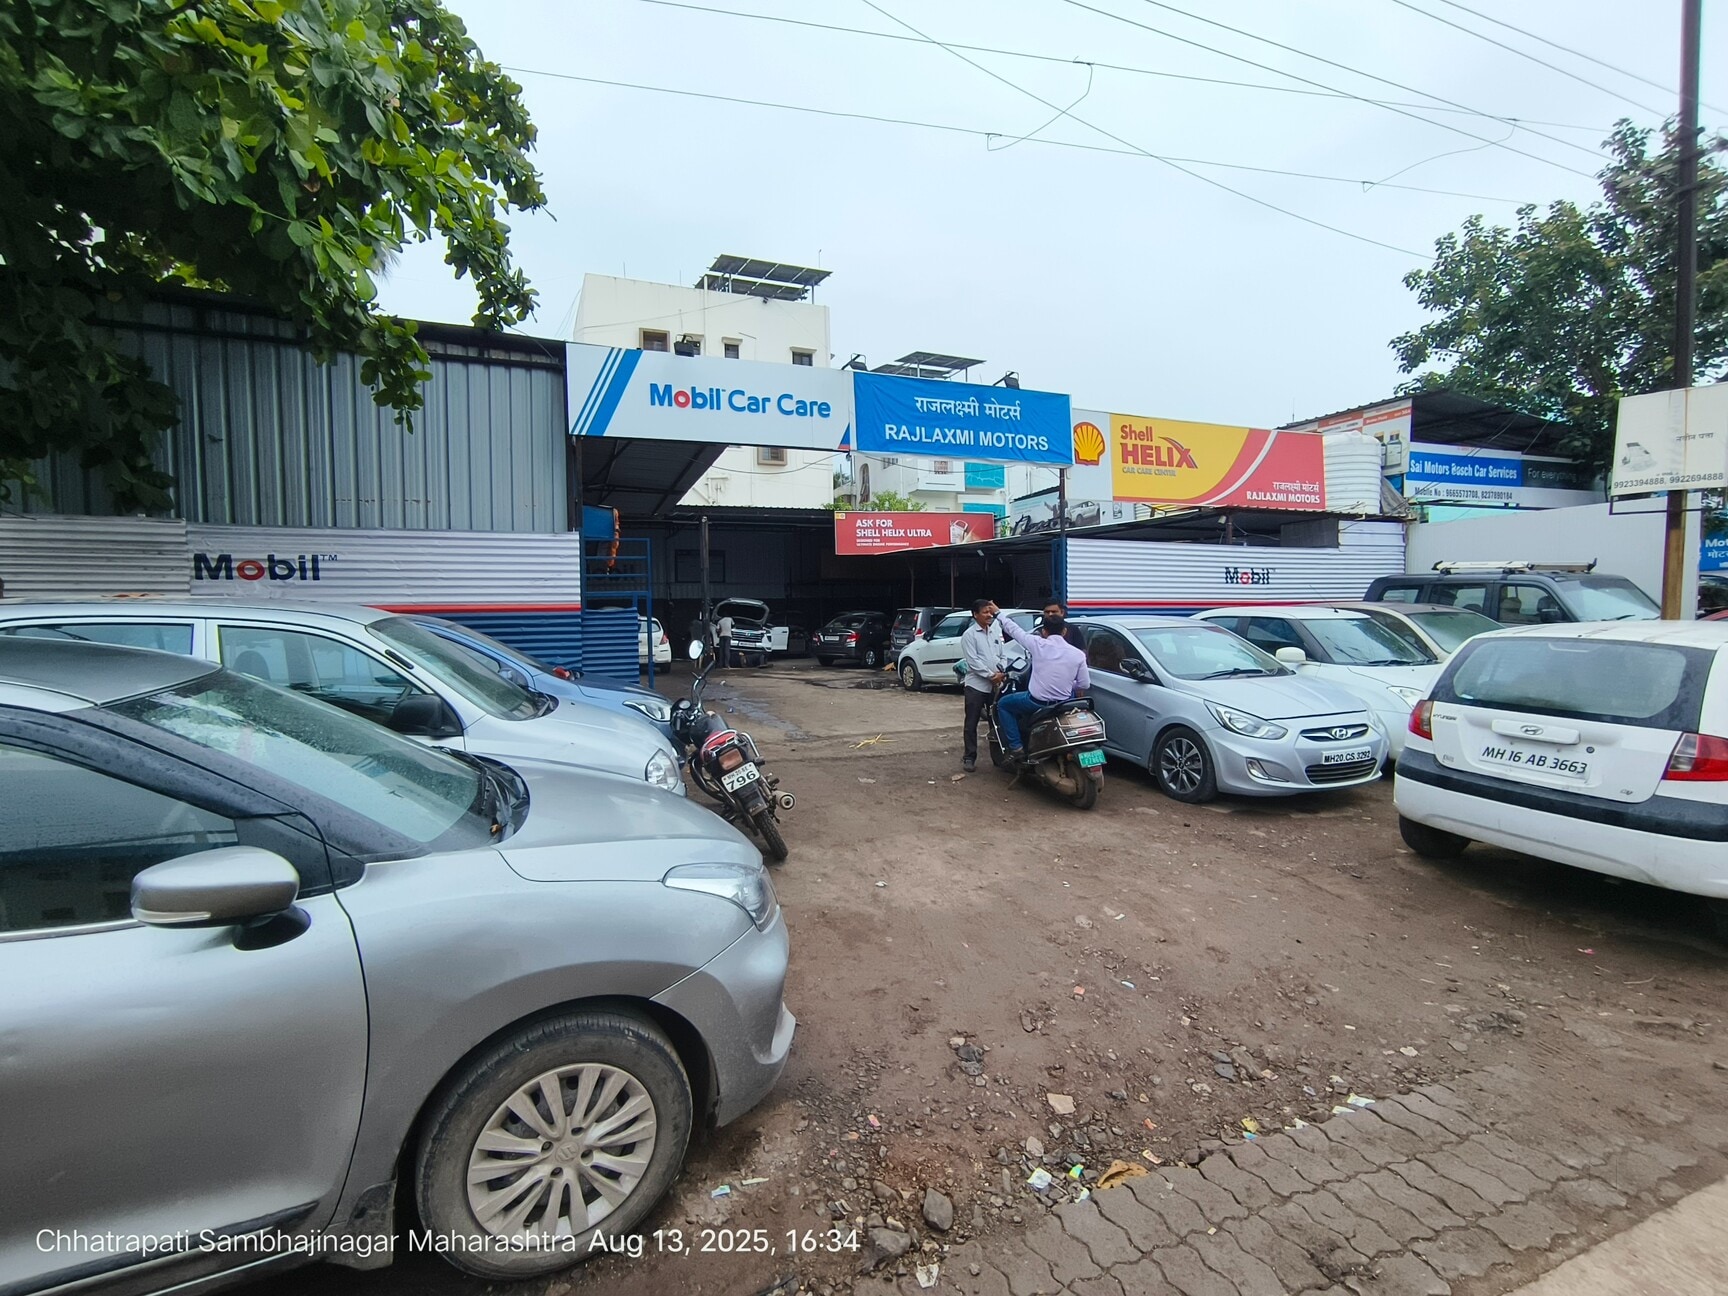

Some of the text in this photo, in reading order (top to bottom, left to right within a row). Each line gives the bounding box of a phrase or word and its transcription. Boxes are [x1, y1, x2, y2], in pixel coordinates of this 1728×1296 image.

[728, 390, 771, 414] Car
[777, 393, 831, 418] Care
[914, 396, 1021, 421] राजलक्ष्मी मोटर्स
[885, 424, 1049, 451] RAJLAXMI MOTORS
[1120, 424, 1153, 442] Shell
[1120, 436, 1198, 469] HELIX
[1410, 460, 1422, 473] Sai
[1424, 460, 1450, 475] Motors
[1474, 464, 1487, 478] Car
[1488, 466, 1517, 480] Services
[1528, 468, 1540, 479] For
[1246, 491, 1320, 504] RAJLAXMI MOTORS
[856, 519, 893, 528] ASK FOR
[856, 529, 932, 537] SHELL HELIX ULTRA
[726, 770, 756, 790] 796
